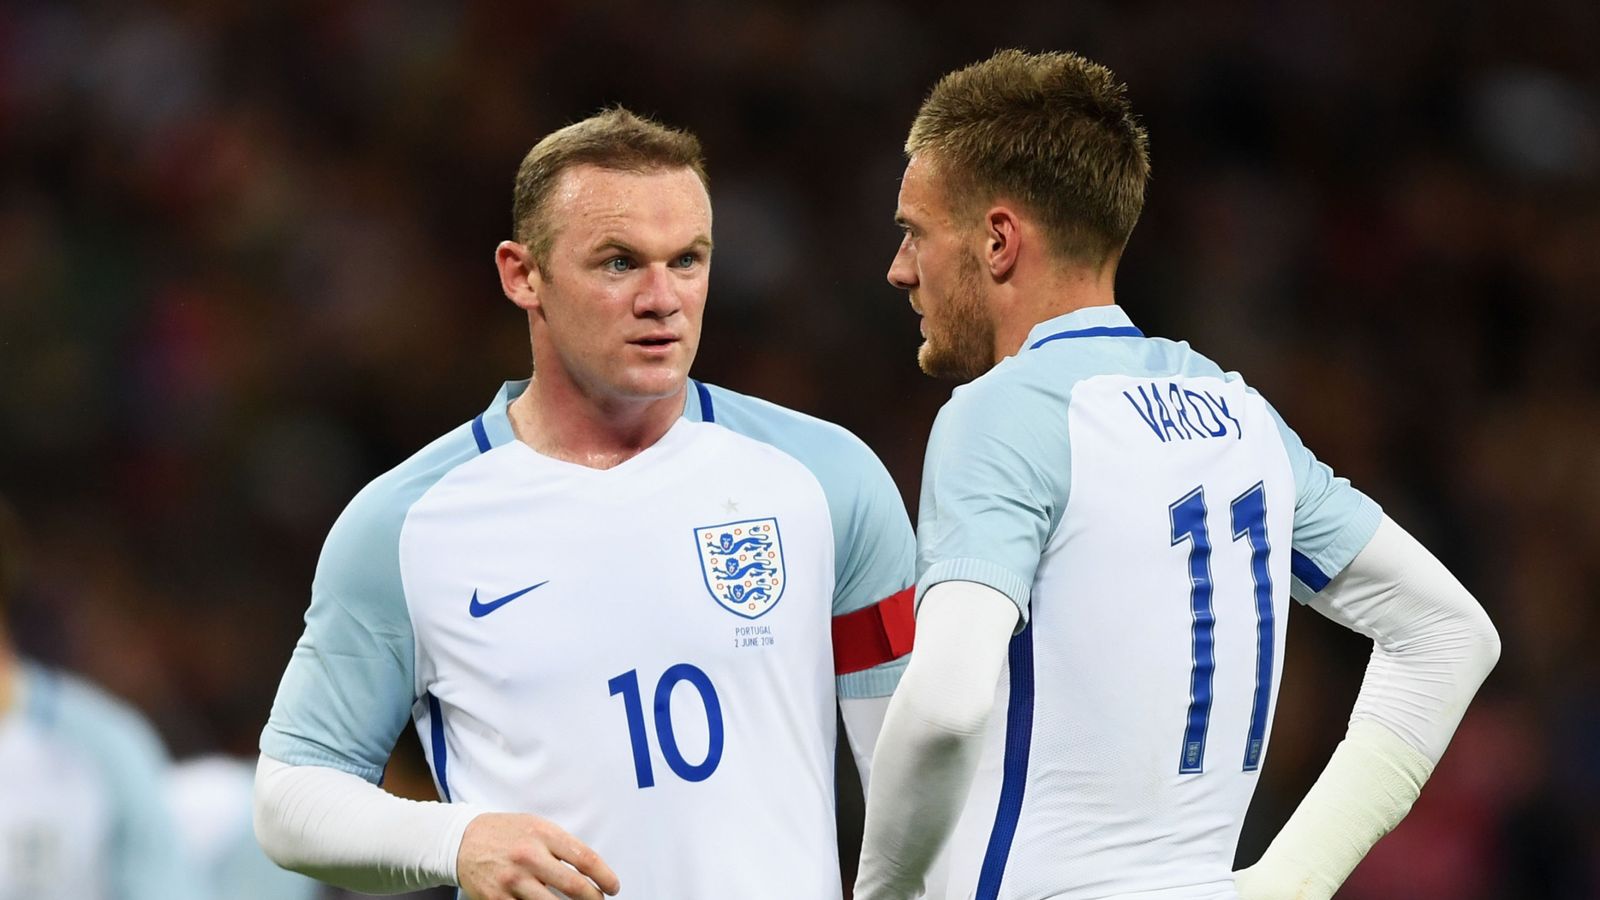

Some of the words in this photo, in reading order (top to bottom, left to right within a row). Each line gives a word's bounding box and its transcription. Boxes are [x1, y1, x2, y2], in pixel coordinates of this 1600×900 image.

[1122, 382, 1241, 442] VARDY
[734, 638, 739, 648] 2
[742, 637, 758, 647] JUNE
[735, 625, 771, 636] PORTUGAL
[1168, 480, 1275, 774] 11
[608, 663, 724, 789] 10
